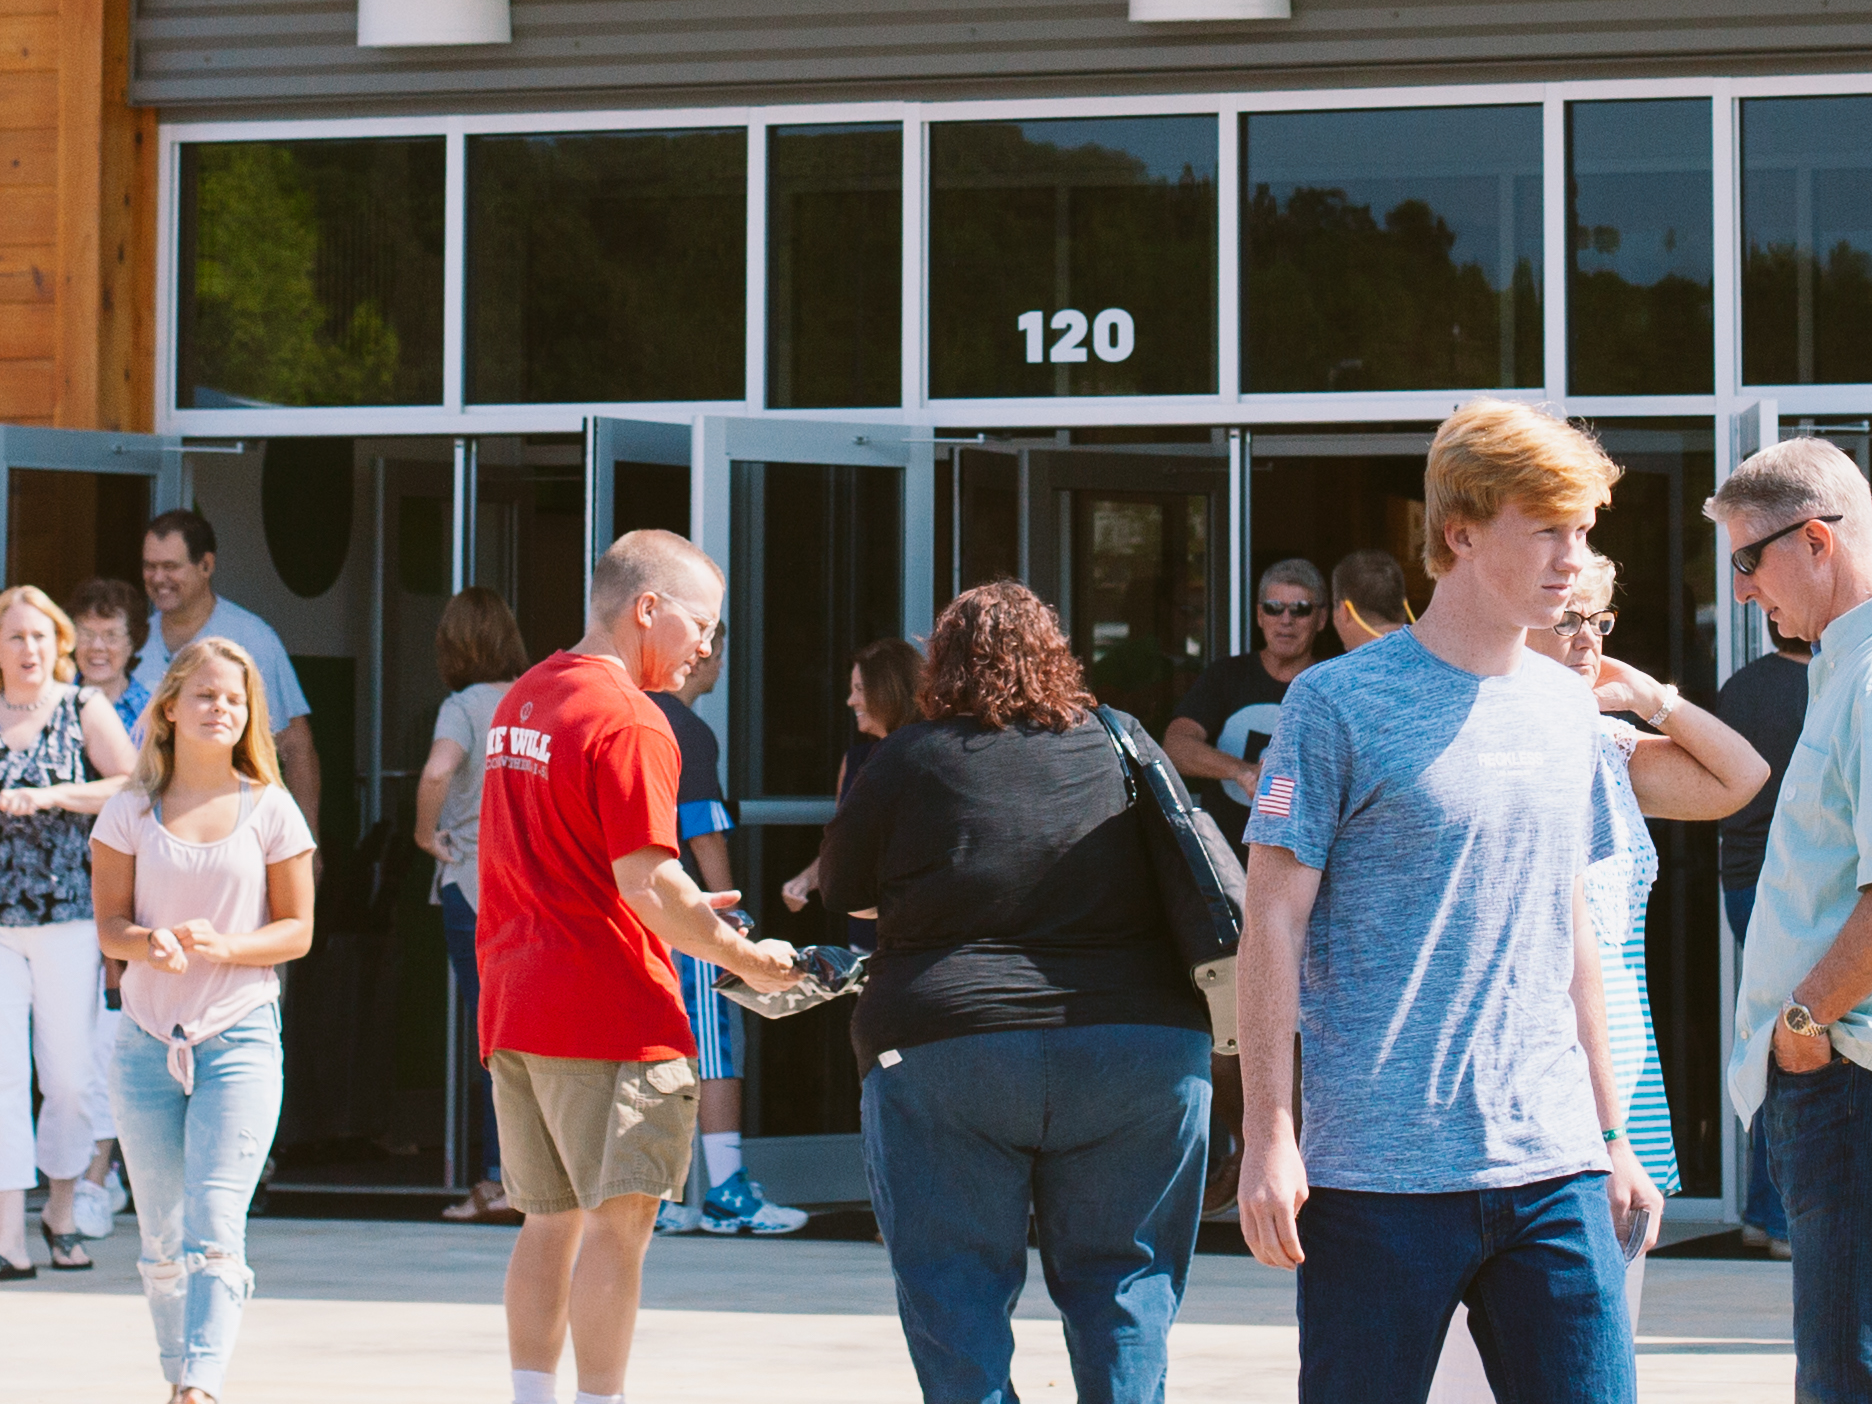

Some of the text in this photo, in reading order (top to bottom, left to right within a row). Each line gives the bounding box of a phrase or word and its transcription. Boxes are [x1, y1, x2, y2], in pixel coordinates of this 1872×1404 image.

[1017, 307, 1135, 363] 120
[510, 726, 552, 764] WILL
[1477, 751, 1544, 767] RECKLESS
